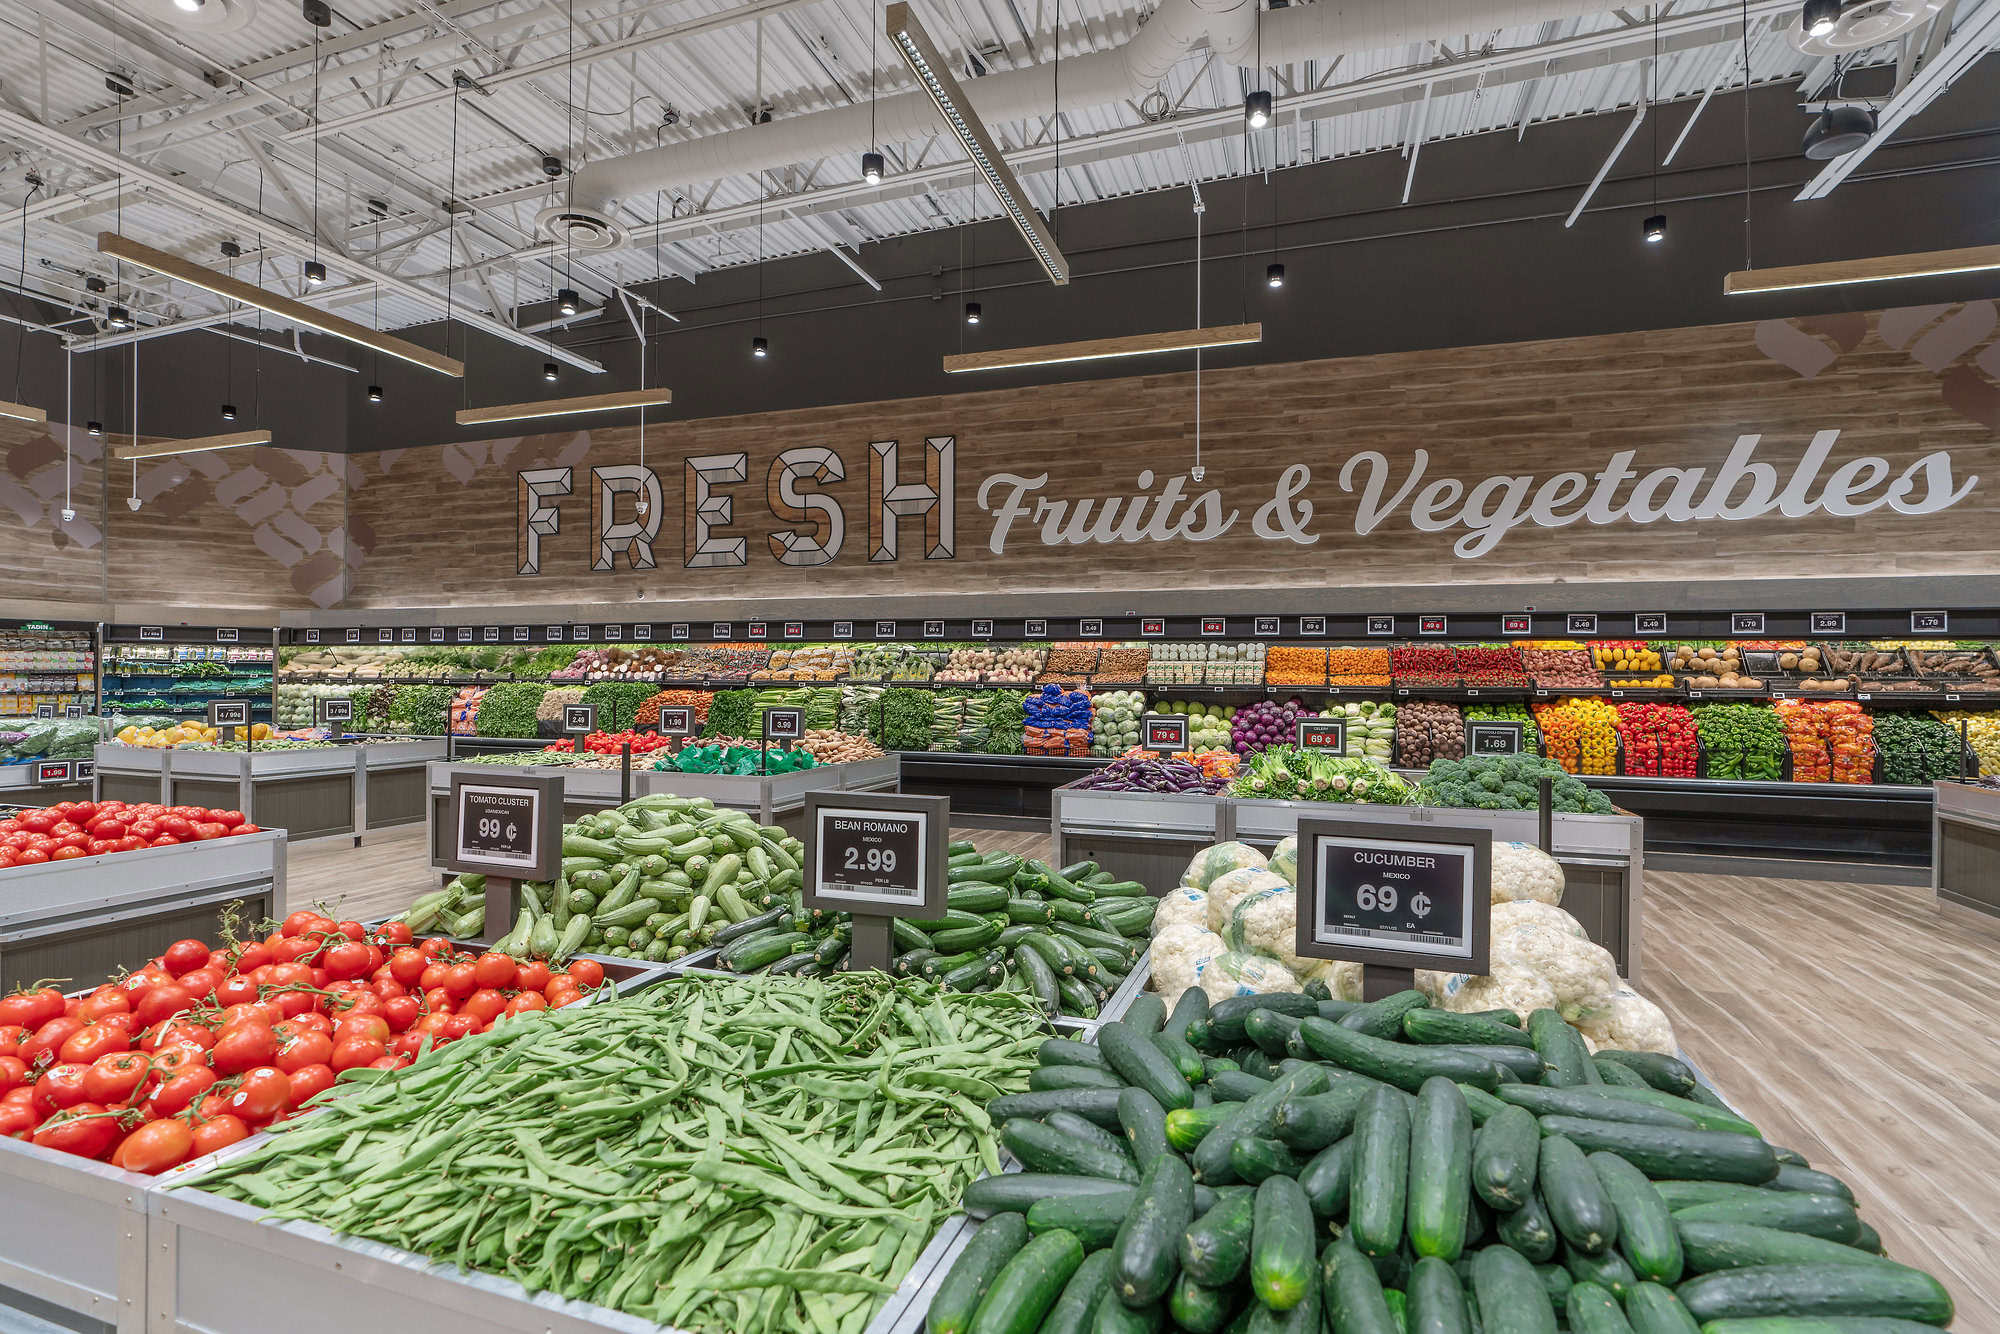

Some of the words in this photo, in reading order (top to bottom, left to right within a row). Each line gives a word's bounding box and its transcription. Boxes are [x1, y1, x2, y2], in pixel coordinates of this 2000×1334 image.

[516, 435, 957, 575] FRESH
[977, 469, 1238, 555] Fruits
[1251, 463, 1320, 544] &
[1339, 429, 1979, 559] Vegetables
[1484, 739, 1506, 748] 1.69
[470, 795, 497, 804] TOMATO
[498, 798, 529, 806] CLUSTER
[479, 818, 500, 838] 99
[506, 822, 517, 842] ¢
[835, 820, 860, 830] BEAN
[864, 822, 908, 833] ROMANO
[844, 847, 896, 872] 2.99
[1354, 852, 1435, 868] CUCUMBER
[1357, 884, 1398, 912] 69
[1410, 892, 1431, 919] ¢
